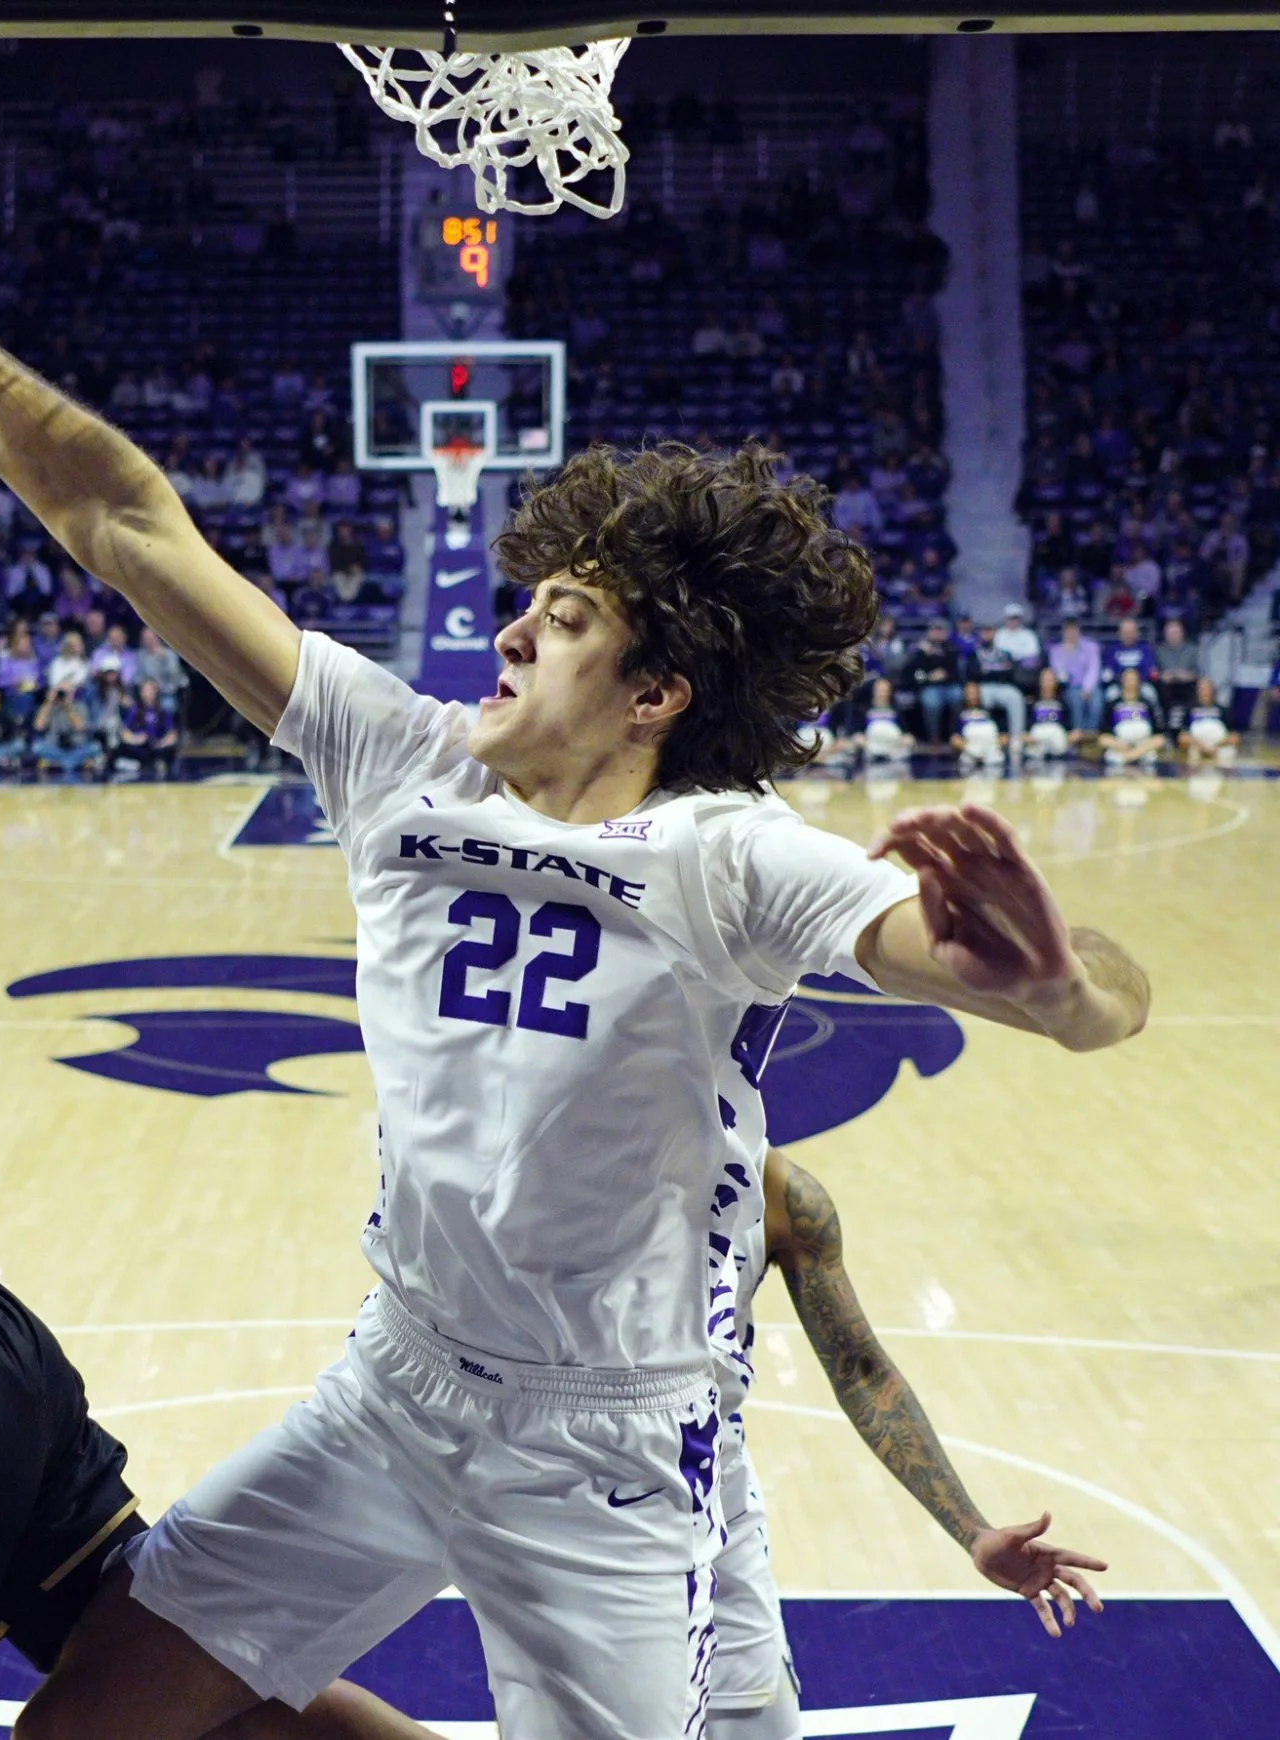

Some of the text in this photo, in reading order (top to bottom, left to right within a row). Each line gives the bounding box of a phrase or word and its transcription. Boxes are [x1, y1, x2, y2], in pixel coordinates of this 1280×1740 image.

[460, 245, 489, 289] 9
[399, 834, 646, 909] K-STATE
[438, 889, 602, 1040] 22
